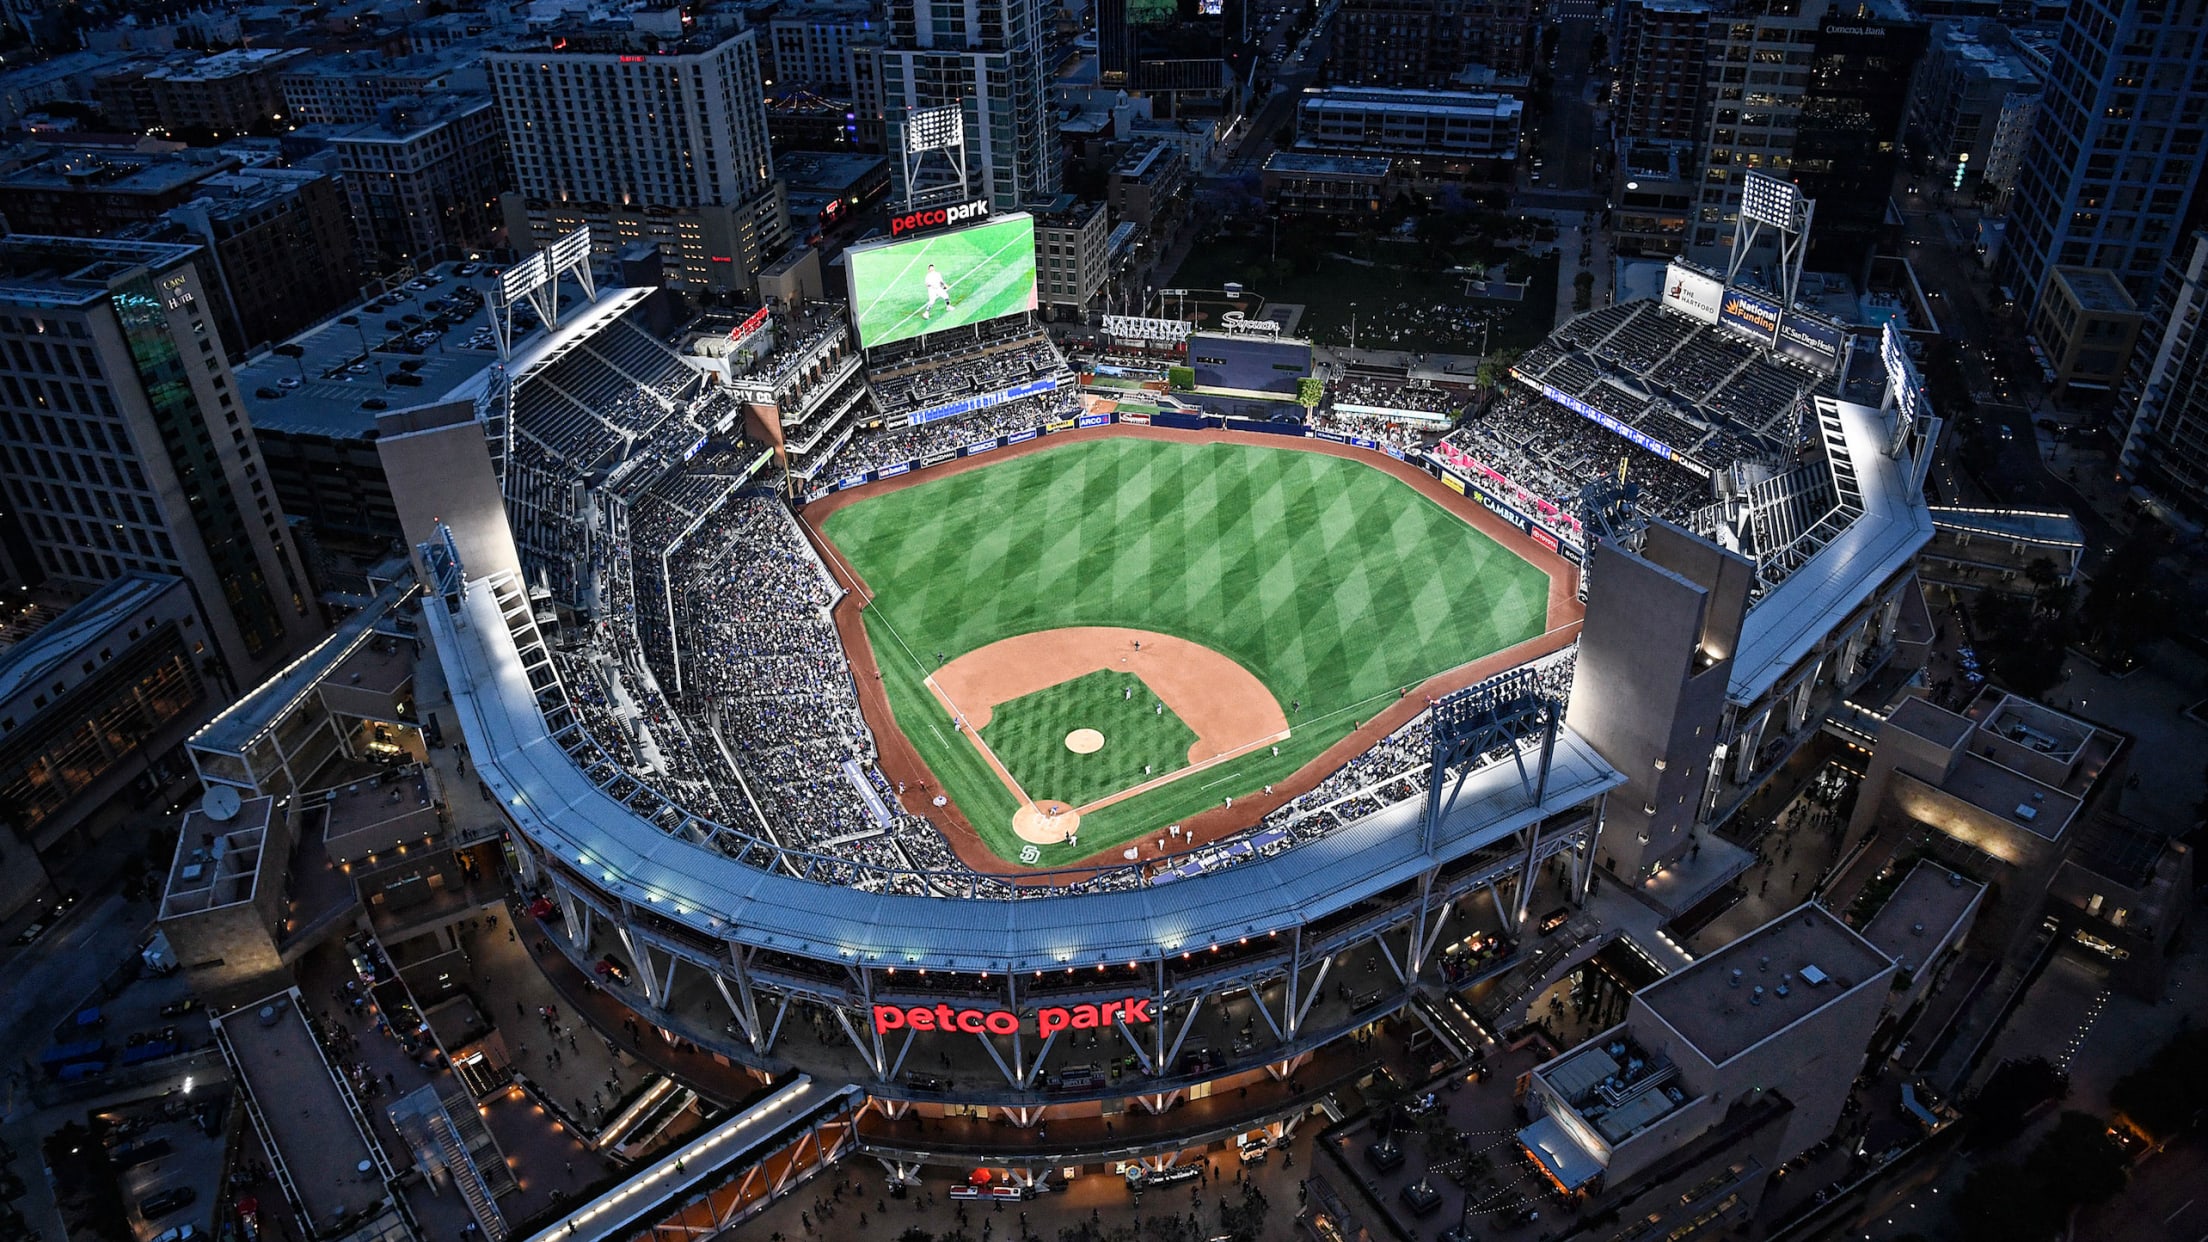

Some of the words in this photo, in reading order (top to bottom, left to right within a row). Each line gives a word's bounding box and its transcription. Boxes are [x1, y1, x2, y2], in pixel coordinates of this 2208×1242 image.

[1683, 288, 1694, 299] THE
[1681, 296, 1715, 314] HARTFORD
[1738, 298, 1777, 322] National
[1102, 315, 1192, 334] NATIONAL
[1737, 308, 1775, 332] Funding
[1109, 327, 1188, 342] UNIVERSITY
[1081, 417, 1102, 426] ARCO
[969, 442, 996, 453] GEICO
[1483, 497, 1526, 531] CAMBRIA
[873, 1003, 1019, 1034] petco
[1038, 998, 1150, 1039] park
